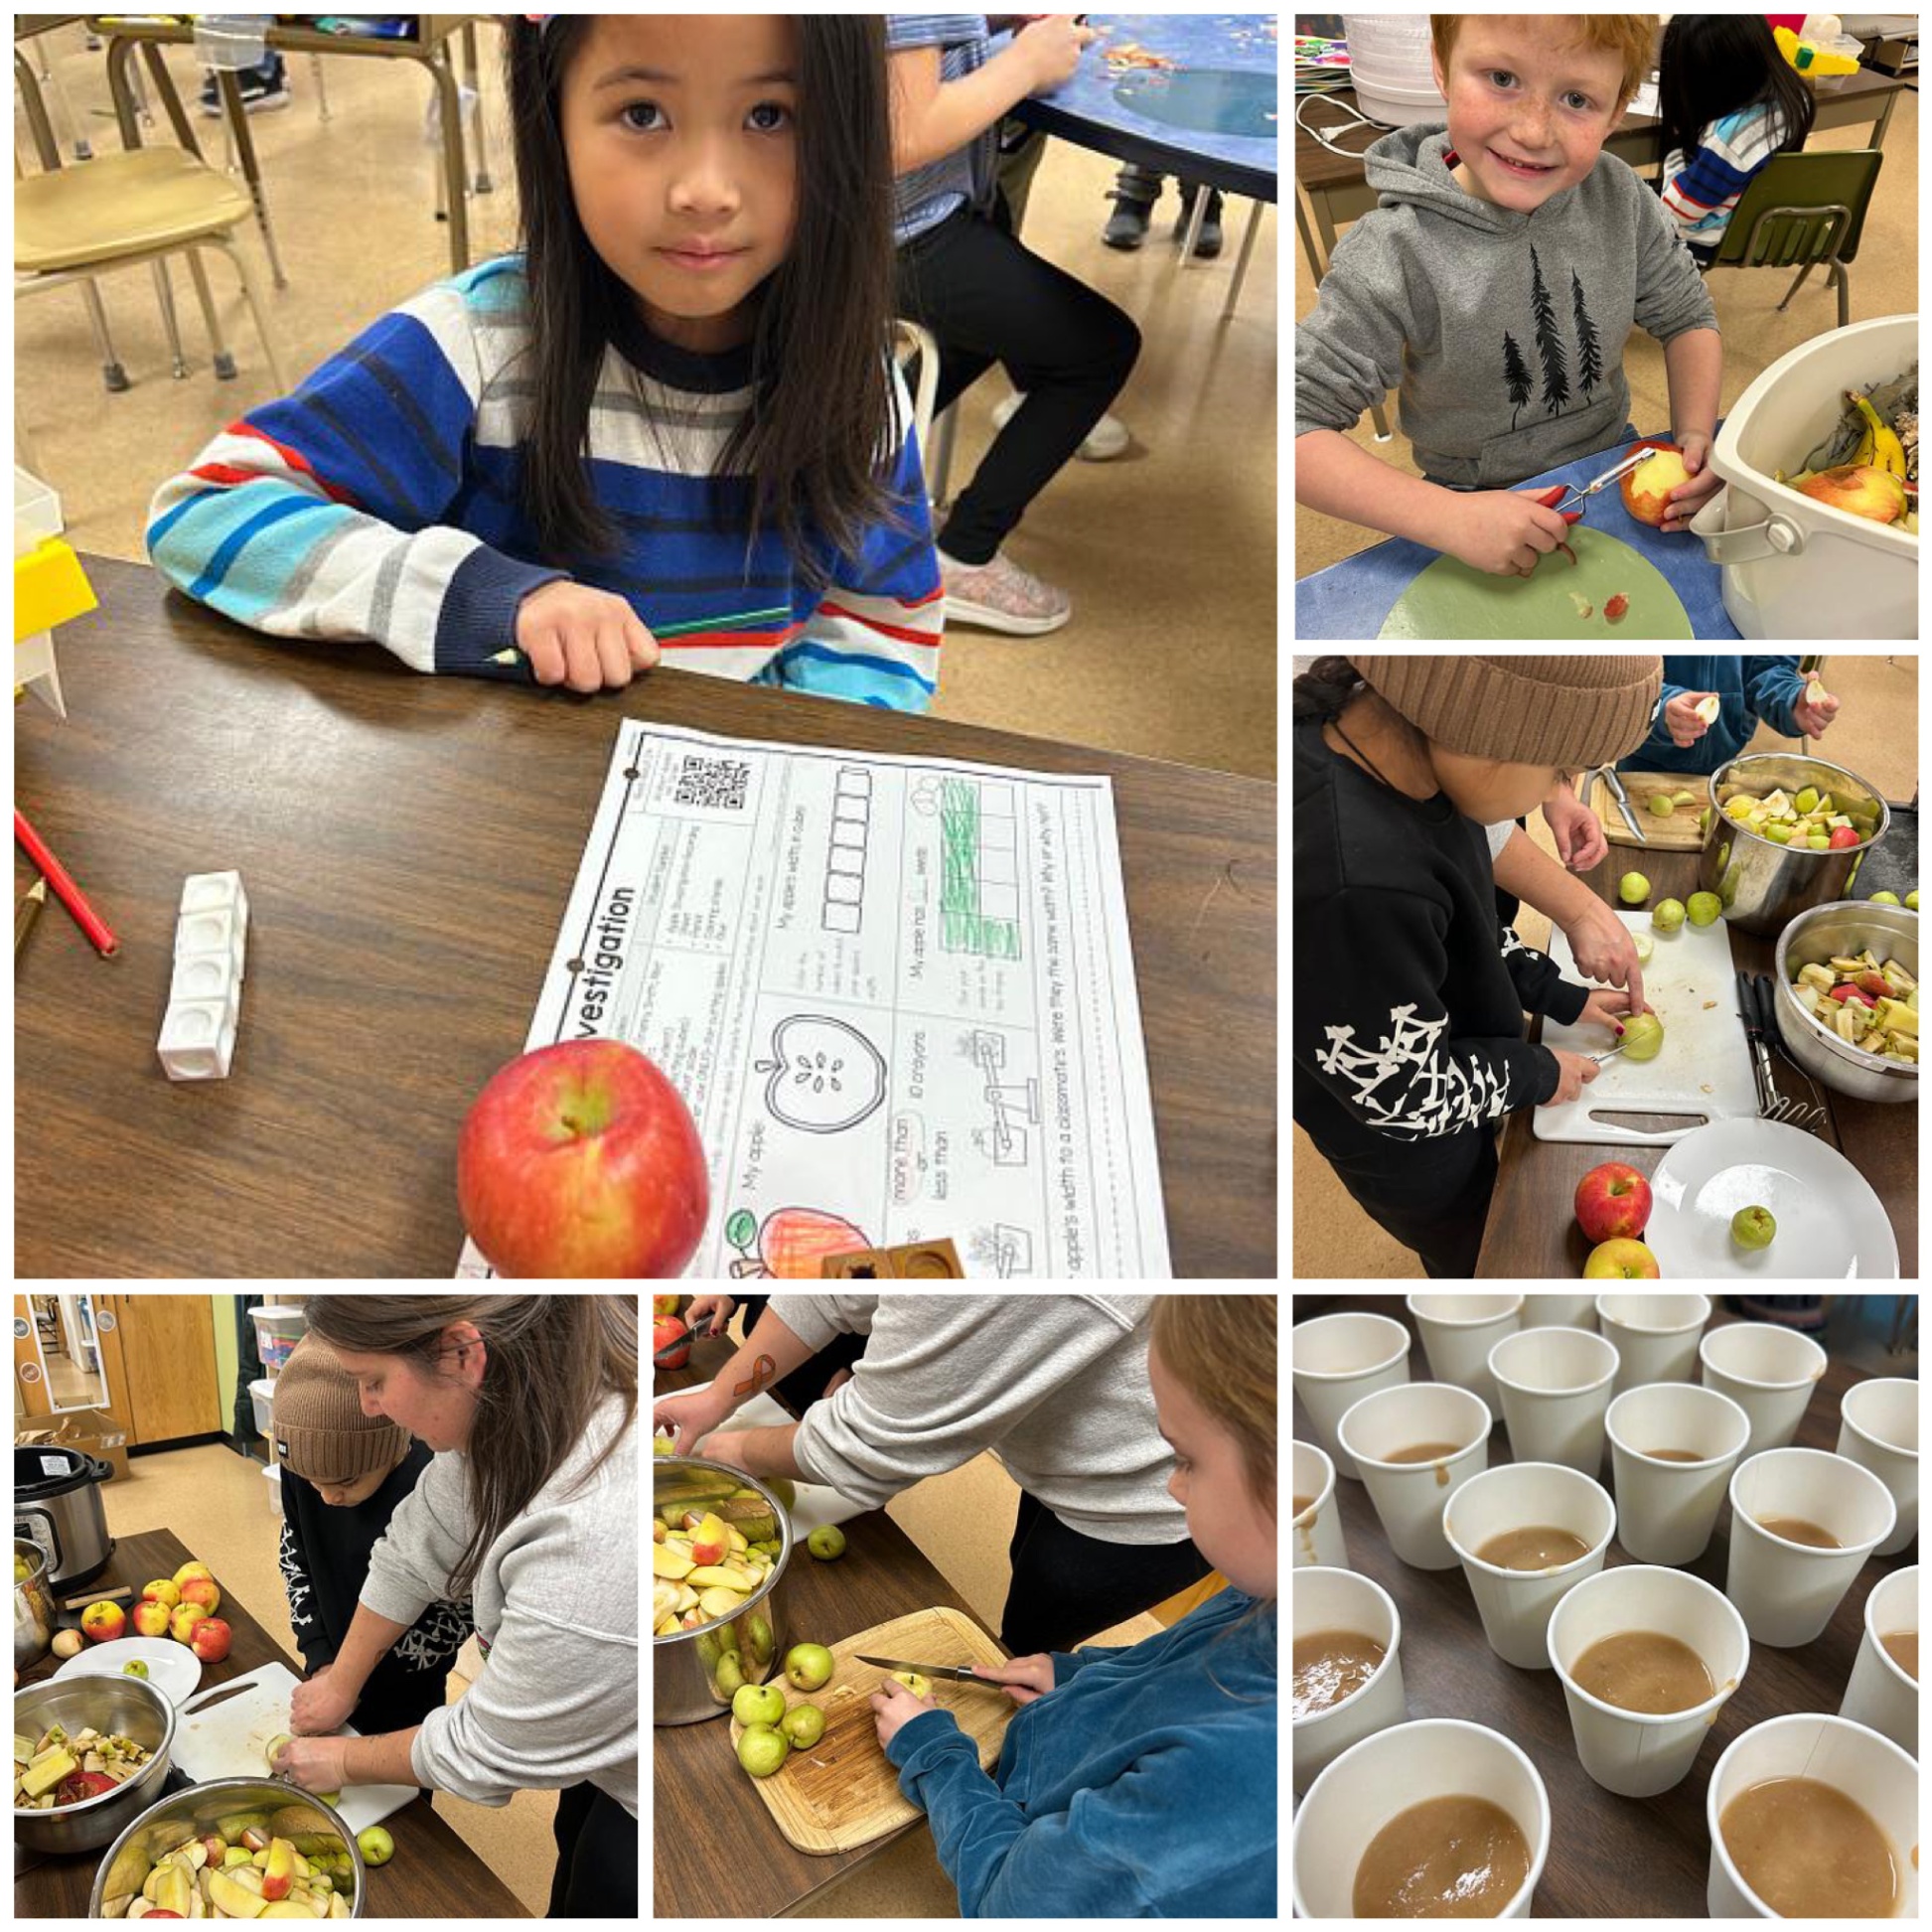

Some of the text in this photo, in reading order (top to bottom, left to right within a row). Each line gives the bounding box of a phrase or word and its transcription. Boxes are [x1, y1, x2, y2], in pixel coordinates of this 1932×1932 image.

[911, 1031, 926, 1083] crayons
[892, 1118, 908, 1201] more than
[932, 1130, 948, 1165] than
[742, 1166, 763, 1190] My
